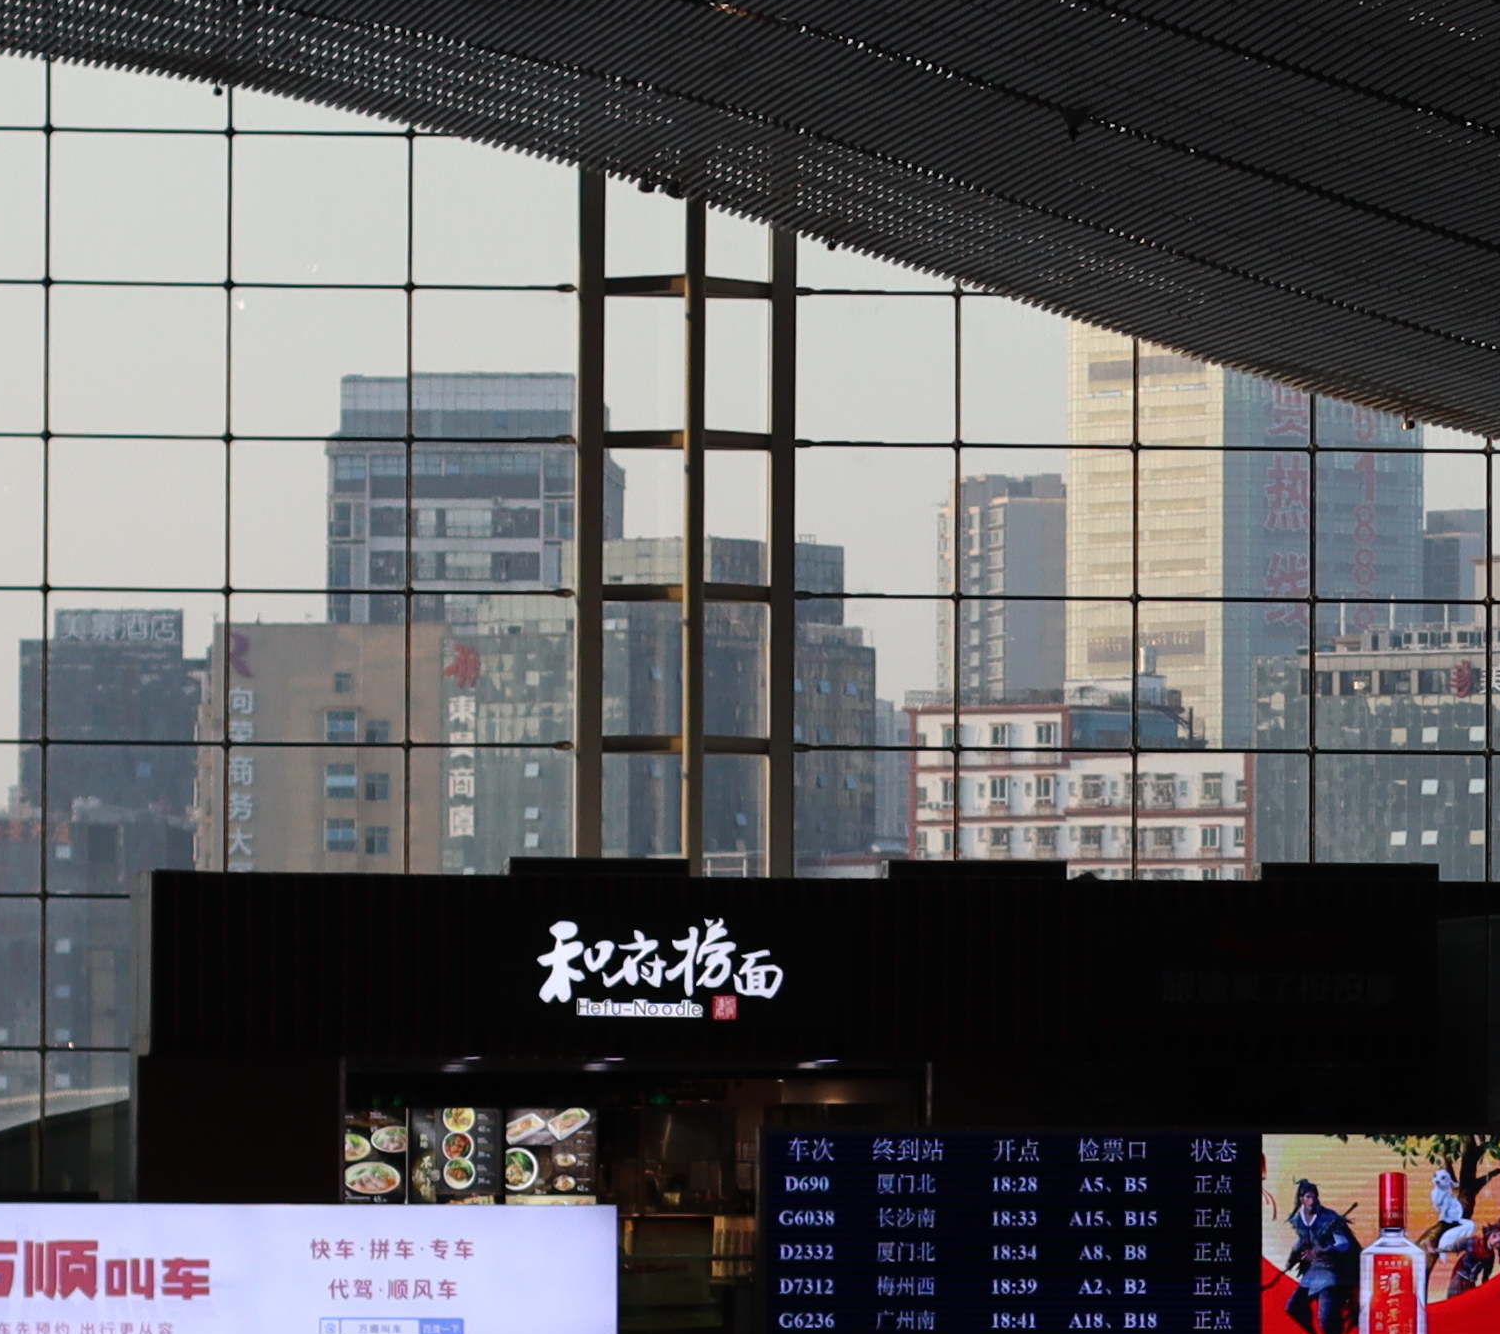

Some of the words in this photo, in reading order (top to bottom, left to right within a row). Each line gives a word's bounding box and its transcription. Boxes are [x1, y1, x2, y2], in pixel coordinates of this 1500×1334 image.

[60, 613, 176, 641] 美景酒店
[229, 687, 254, 872] 向荣商务大
[536, 918, 785, 1005] 和府捞面
[577, 997, 702, 1017] Hefu-Noodle
[787, 1139, 835, 1163] 车次
[872, 1139, 945, 1163] 终到站
[993, 1140, 1041, 1163] 开点
[1077, 1139, 1149, 1163] 检票口
[1190, 1139, 1239, 1163] 状态
[784, 1175, 830, 1194] D690
[876, 1174, 937, 1195] 厦门北
[990, 1175, 1039, 1194] 18:28
[1193, 1174, 1234, 1195] 正点
[778, 1210, 835, 1228] G6038
[876, 1209, 937, 1229] 长沙南
[990, 1210, 1039, 1228] 18:33
[1193, 1209, 1234, 1229] 正点
[778, 1244, 835, 1262] D2332
[876, 1243, 937, 1263] 厦门北
[990, 1244, 1039, 1262] 18:34
[1193, 1243, 1234, 1263] 正点
[328, 1278, 458, 1300] 代驾·顺风车
[778, 1277, 835, 1295] D7312
[876, 1276, 937, 1296] 梅州西
[990, 1277, 1039, 1295] 18:39
[1193, 1276, 1234, 1296] 正点
[778, 1311, 835, 1330] G6236
[876, 1310, 937, 1331] 广州南
[990, 1311, 1039, 1330] 18:41
[1193, 1310, 1234, 1331] 正点
